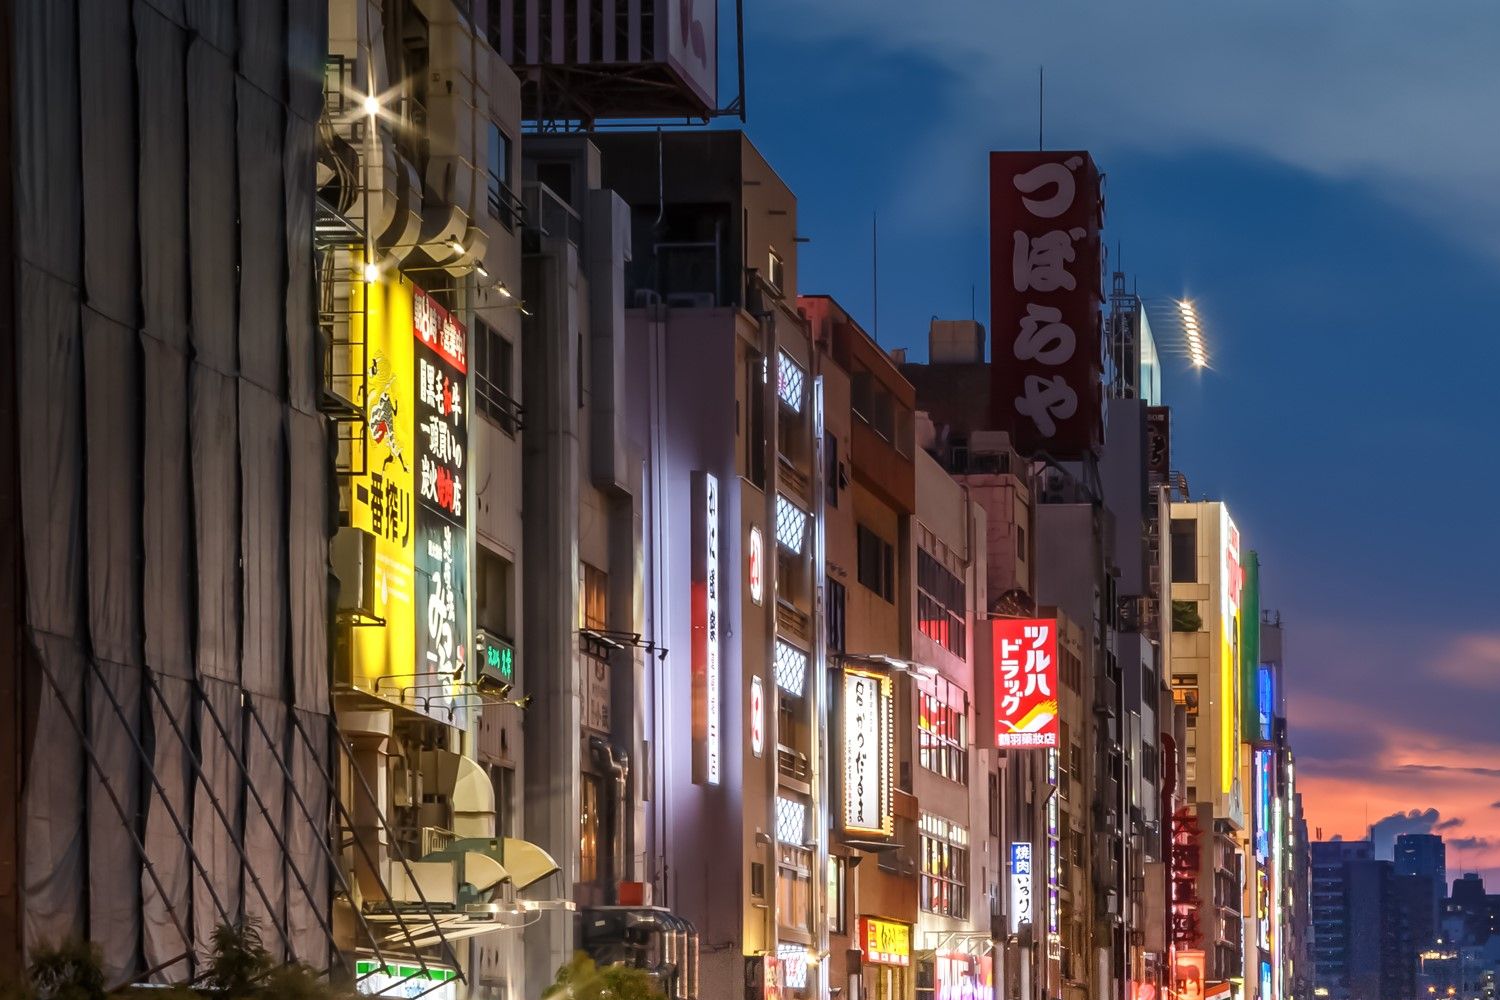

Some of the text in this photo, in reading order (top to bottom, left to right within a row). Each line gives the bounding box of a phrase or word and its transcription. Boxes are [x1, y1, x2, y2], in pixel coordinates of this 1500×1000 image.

[1013, 156, 1086, 438] づぼらや
[357, 471, 410, 548] 一番搾り
[1001, 638, 1023, 716] ドラッグ
[1024, 626, 1051, 697] ツルハ
[1015, 845, 1030, 874] 焼肉
